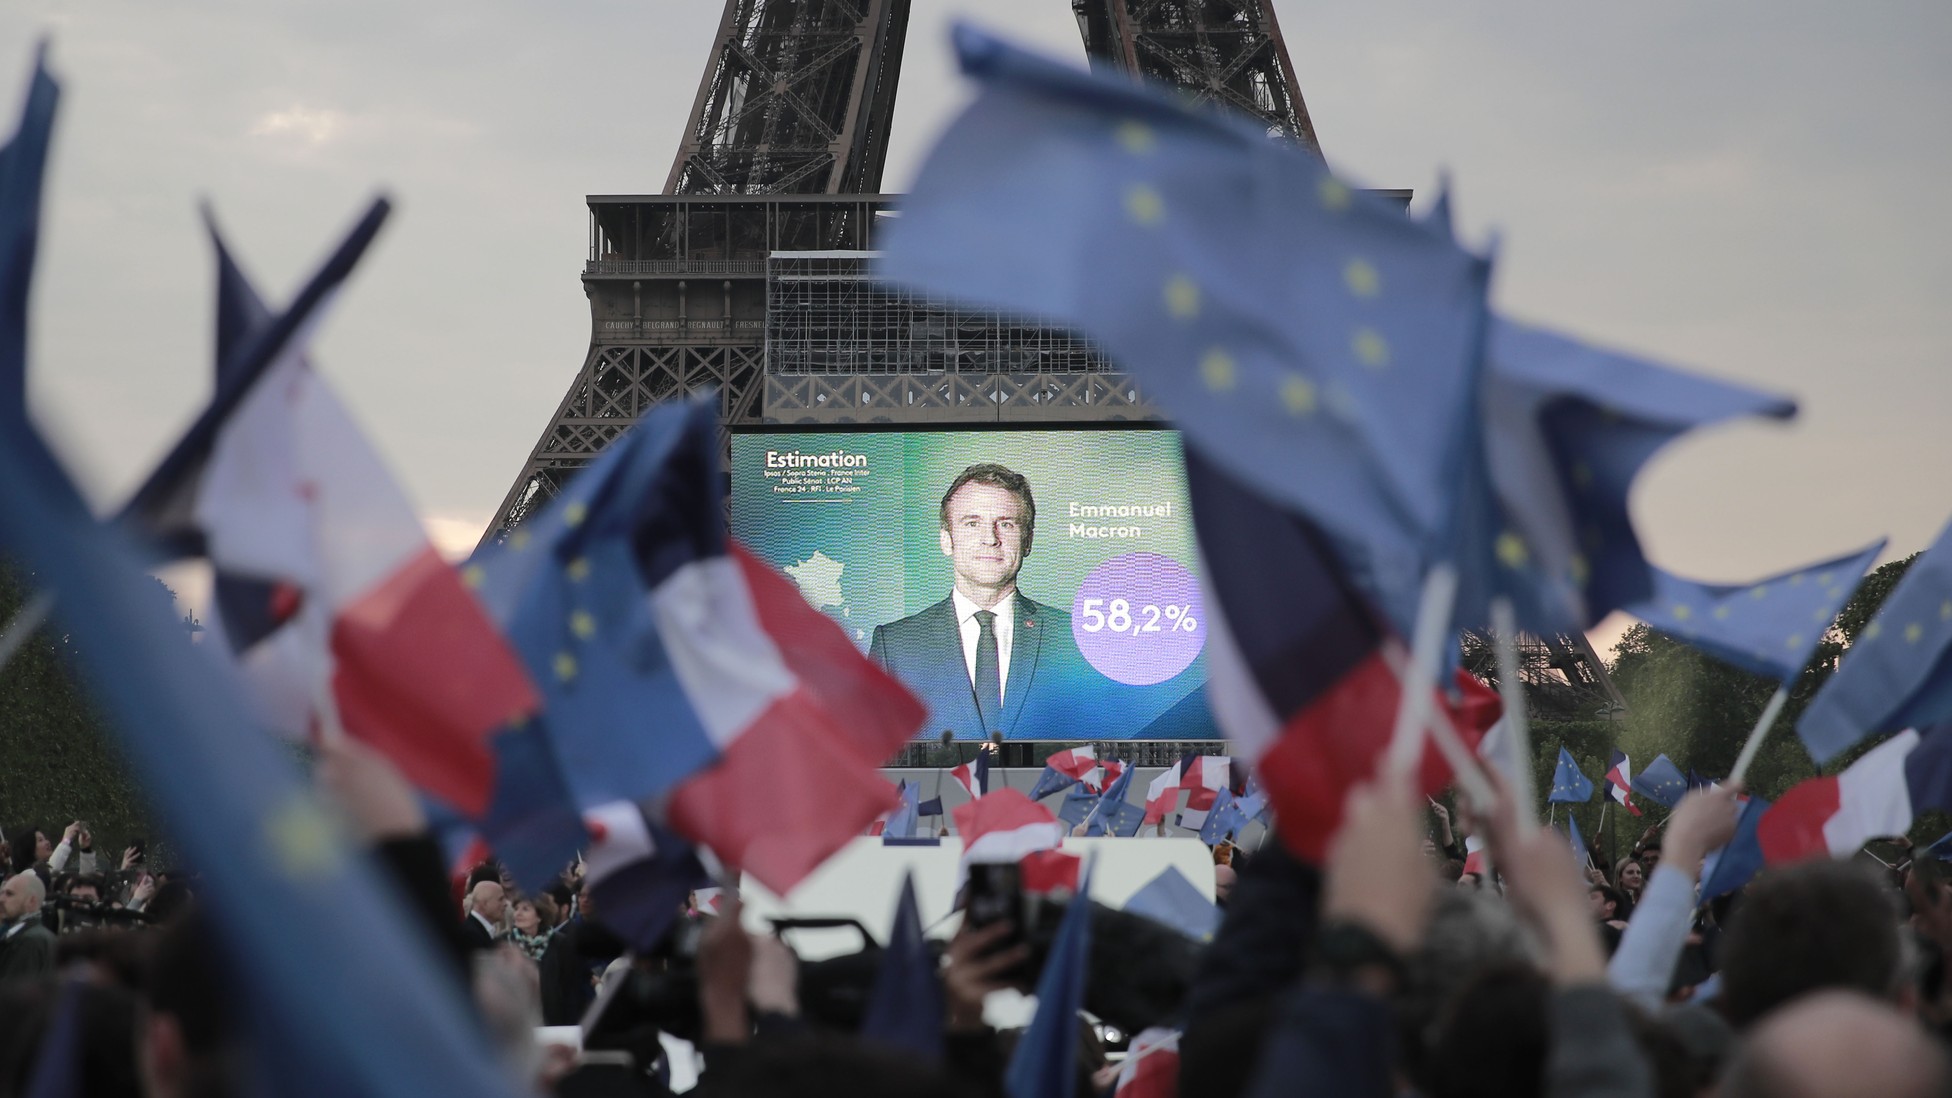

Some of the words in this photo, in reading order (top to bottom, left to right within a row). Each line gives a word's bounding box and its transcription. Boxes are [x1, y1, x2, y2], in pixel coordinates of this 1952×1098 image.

[642, 321, 680, 329] BELGRAND
[687, 321, 724, 329] REGNAULT
[766, 450, 867, 468] Estimation
[1069, 501, 1172, 517] Emmanuel
[1069, 523, 1142, 538] Macron
[1081, 598, 1198, 637] 58,2%
